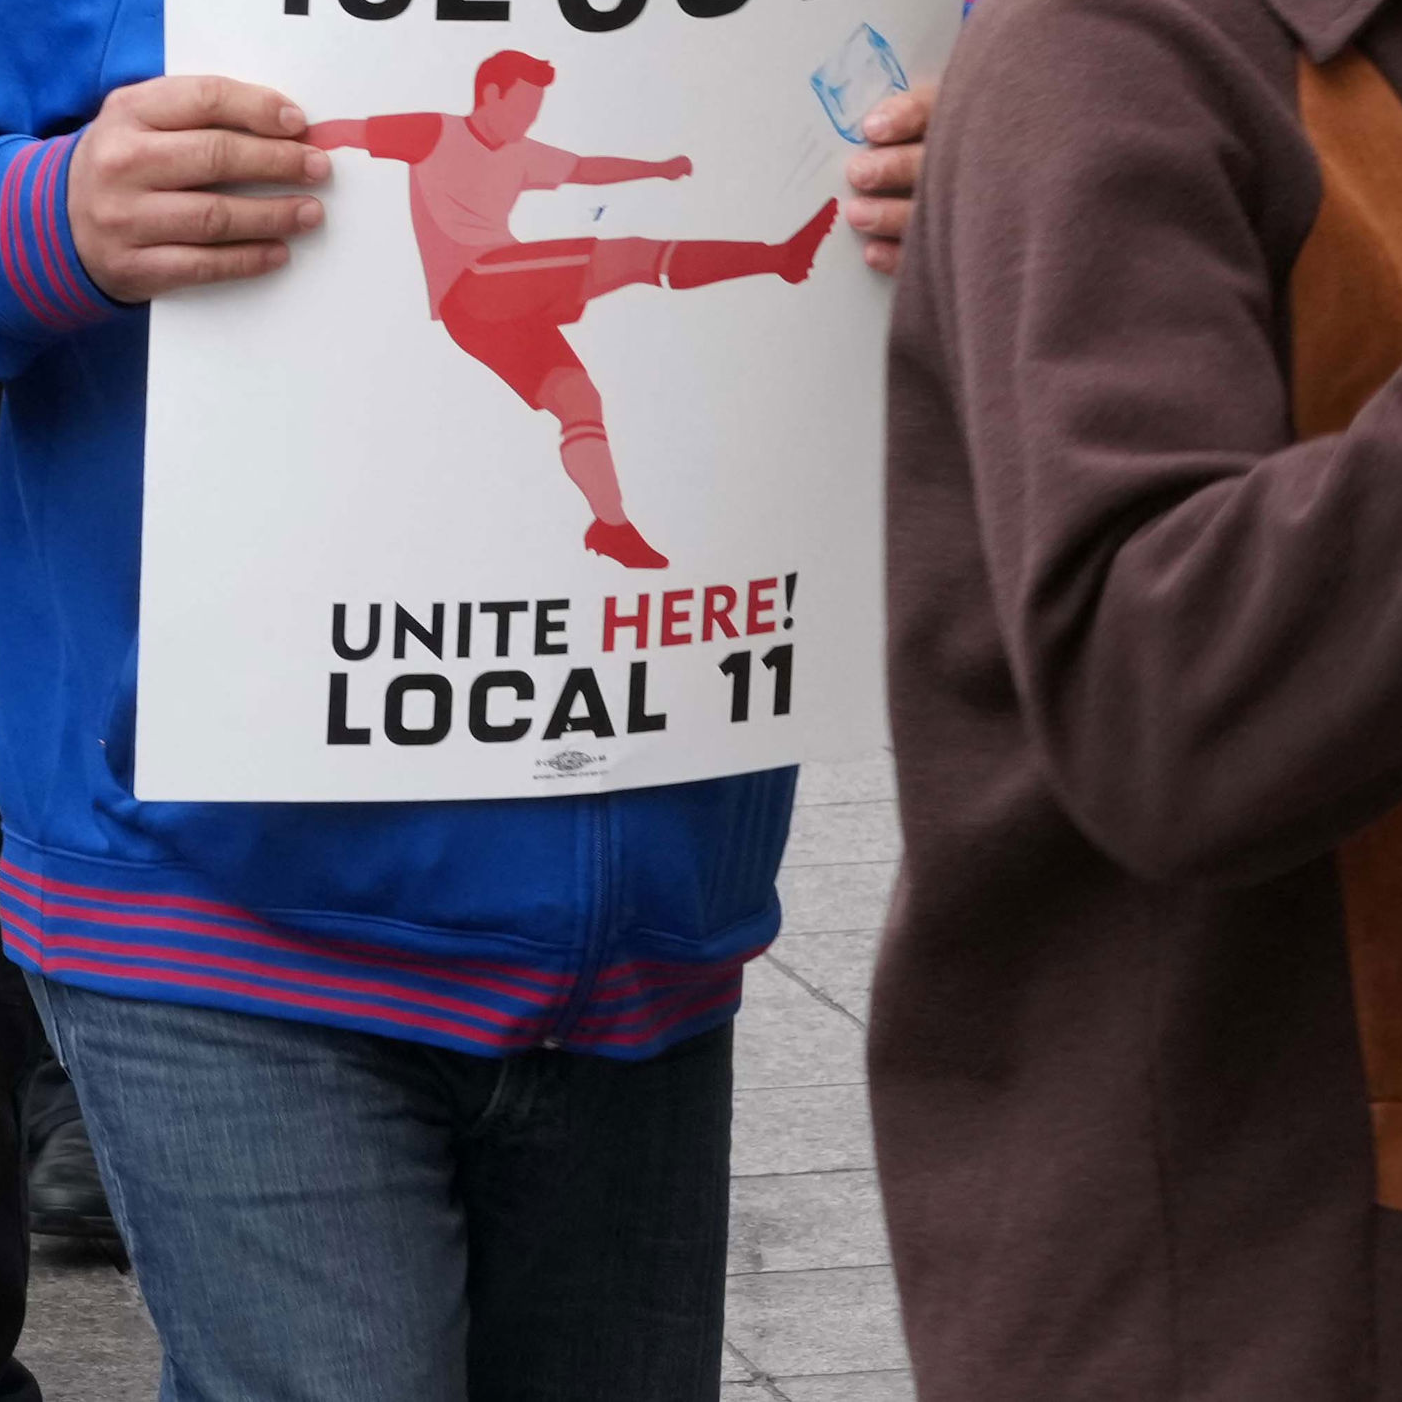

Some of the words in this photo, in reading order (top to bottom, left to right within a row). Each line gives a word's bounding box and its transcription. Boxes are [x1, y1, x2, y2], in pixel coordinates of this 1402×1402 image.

[331, 598, 571, 661] UNITE
[601, 572, 799, 653] HERE!
[326, 661, 668, 746] LOCAL
[718, 643, 795, 724] 11
